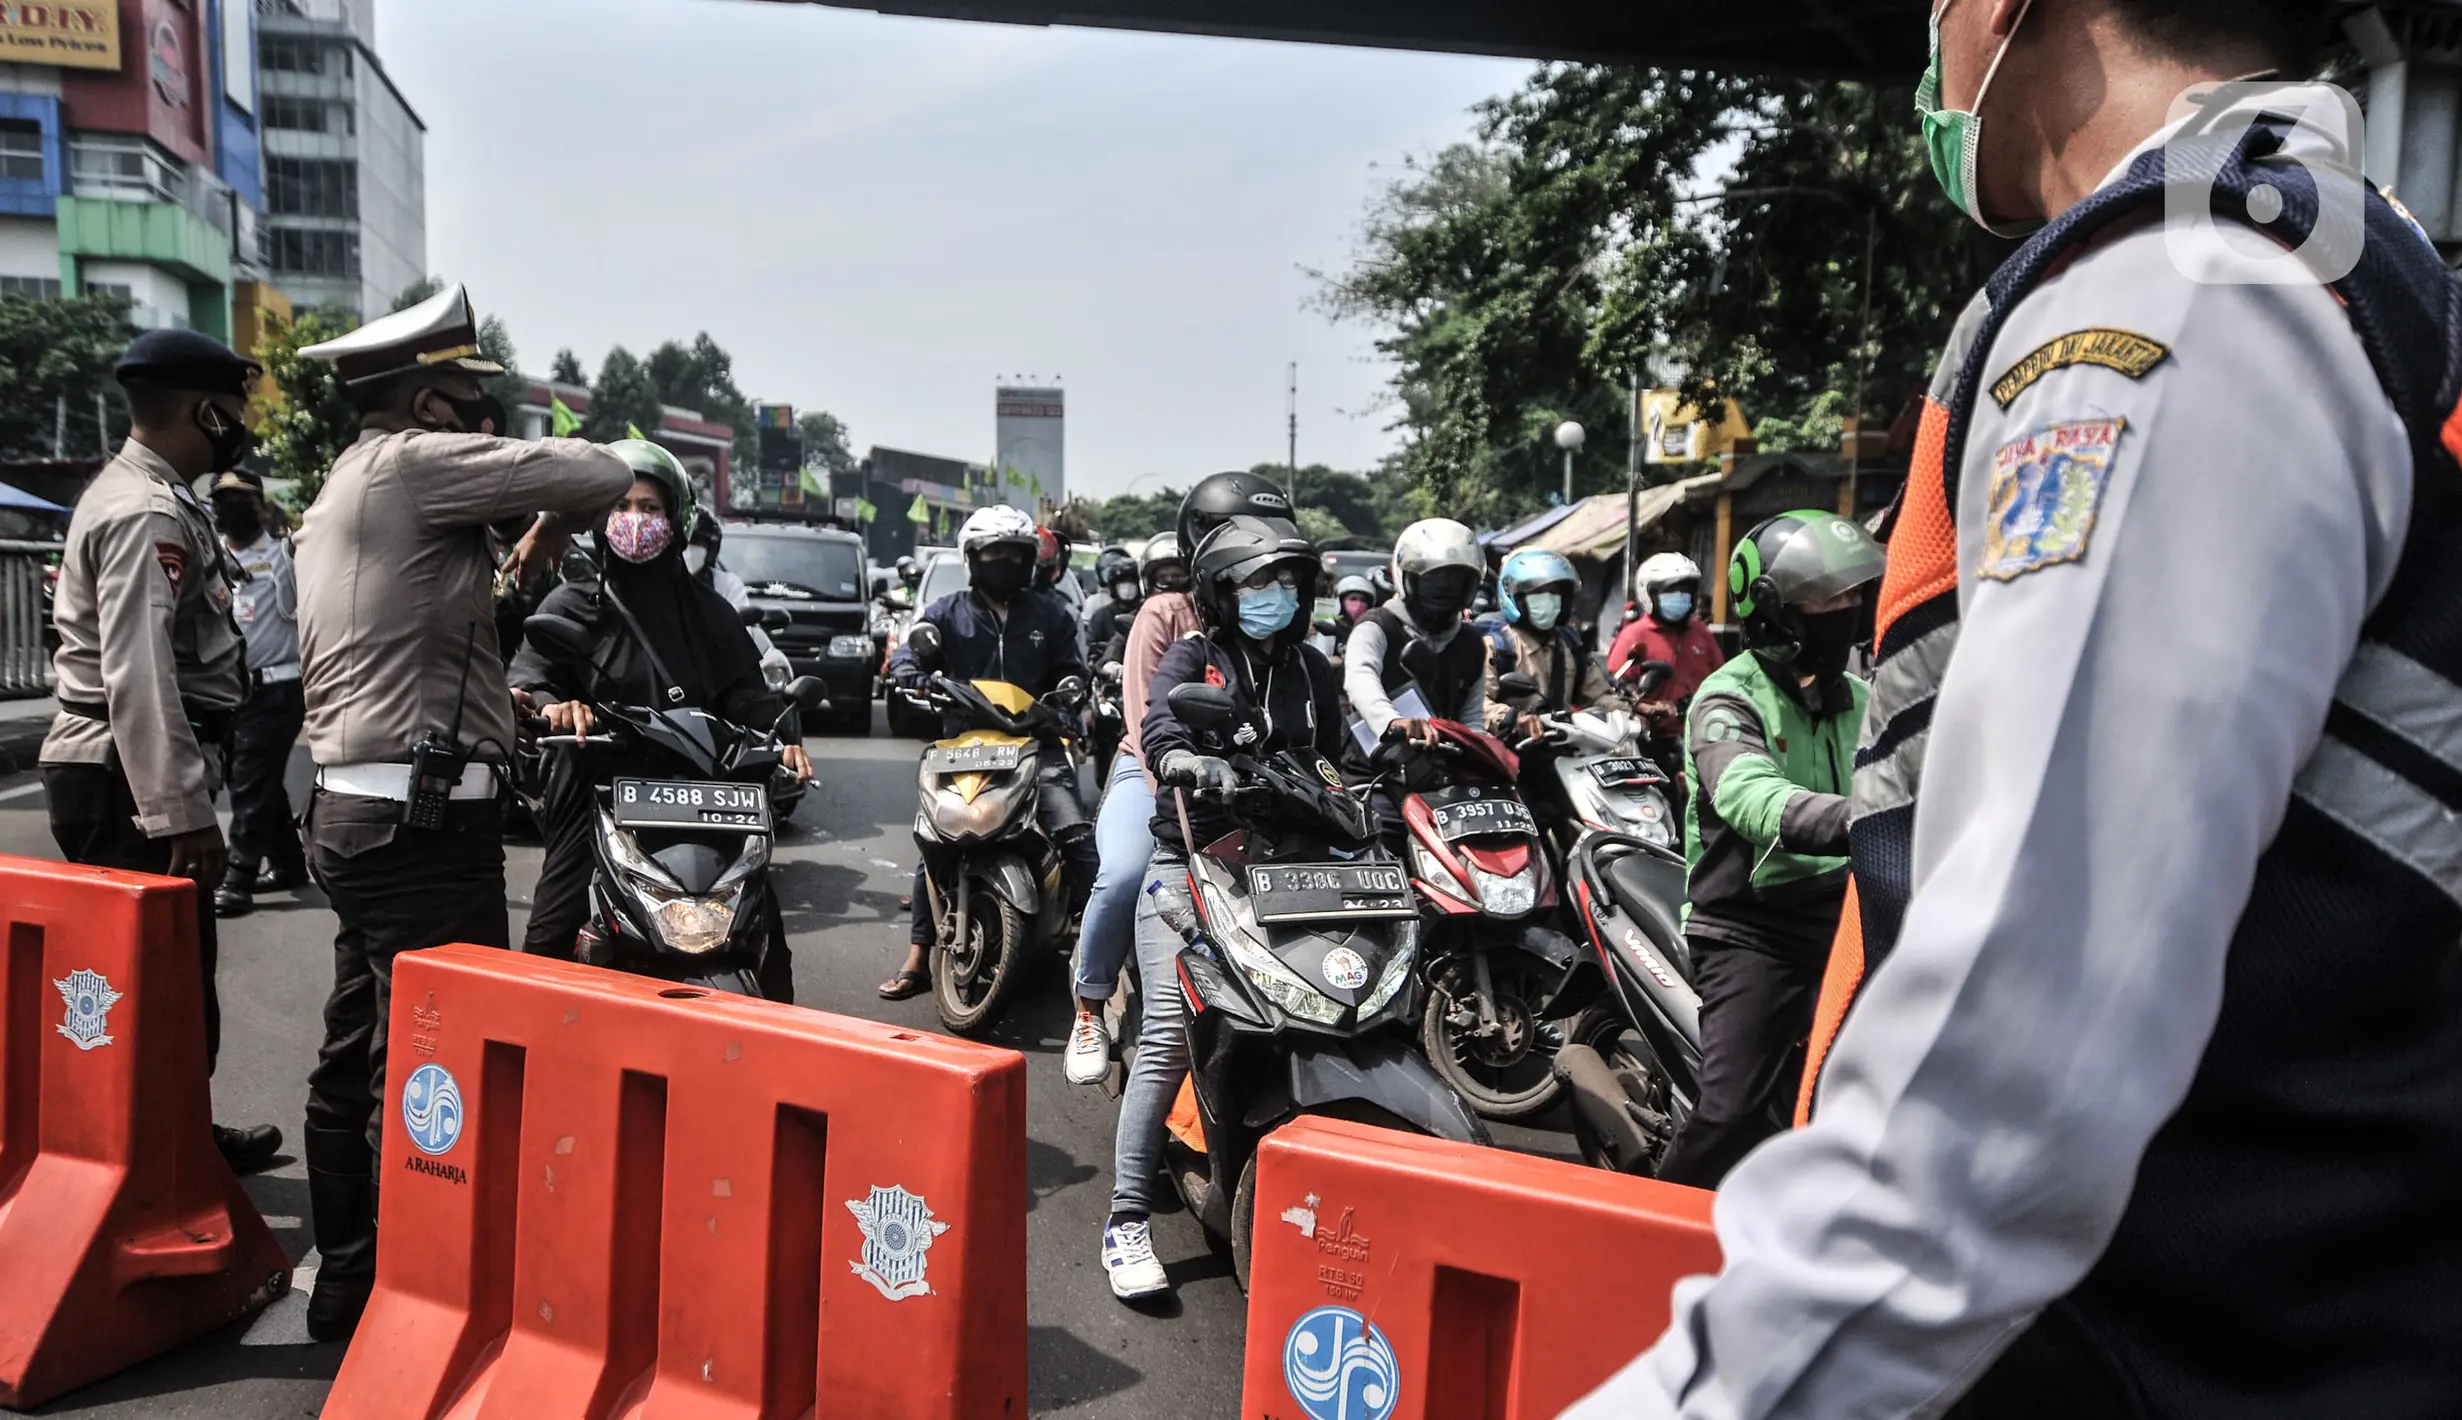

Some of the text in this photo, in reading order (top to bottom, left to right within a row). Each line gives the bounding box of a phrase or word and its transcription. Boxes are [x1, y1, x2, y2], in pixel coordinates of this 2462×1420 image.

[997, 746, 1016, 757] RW
[623, 785, 754, 808] B 4588 SJW
[1436, 802, 1530, 825] B 3957 UJS
[1257, 871, 1272, 892] B
[1624, 928, 1677, 987] VARIO
[1335, 970, 1363, 985] MAG
[1317, 1237, 1369, 1263] Penguin
[1319, 1265, 1345, 1281] RTB
